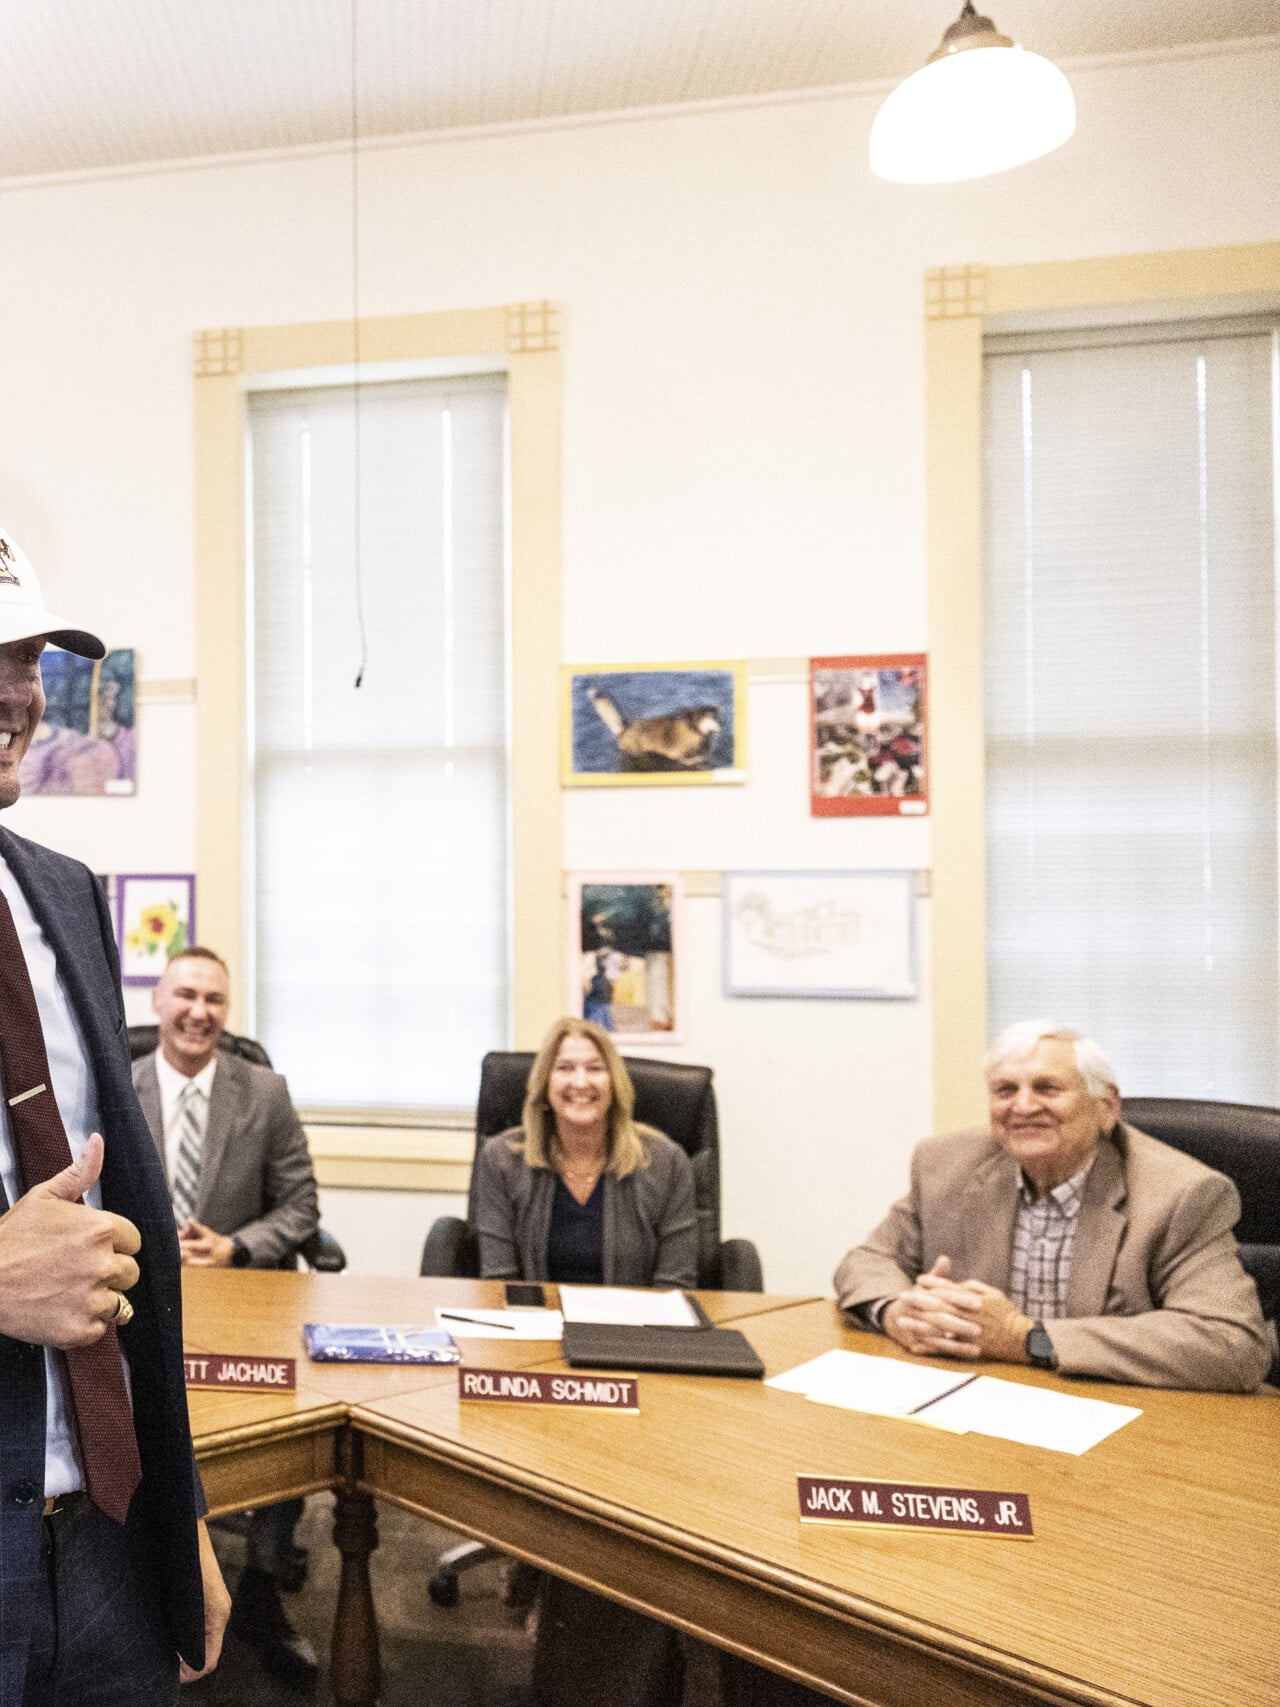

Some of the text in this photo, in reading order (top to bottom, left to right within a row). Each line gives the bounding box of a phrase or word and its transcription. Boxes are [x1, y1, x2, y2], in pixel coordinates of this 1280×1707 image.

[217, 1362, 289, 1385] JACHADE
[464, 1374, 632, 1404] ROLINDA SCHMIDT
[807, 1487, 1023, 1526] JACK M. STEVENS, JR.
